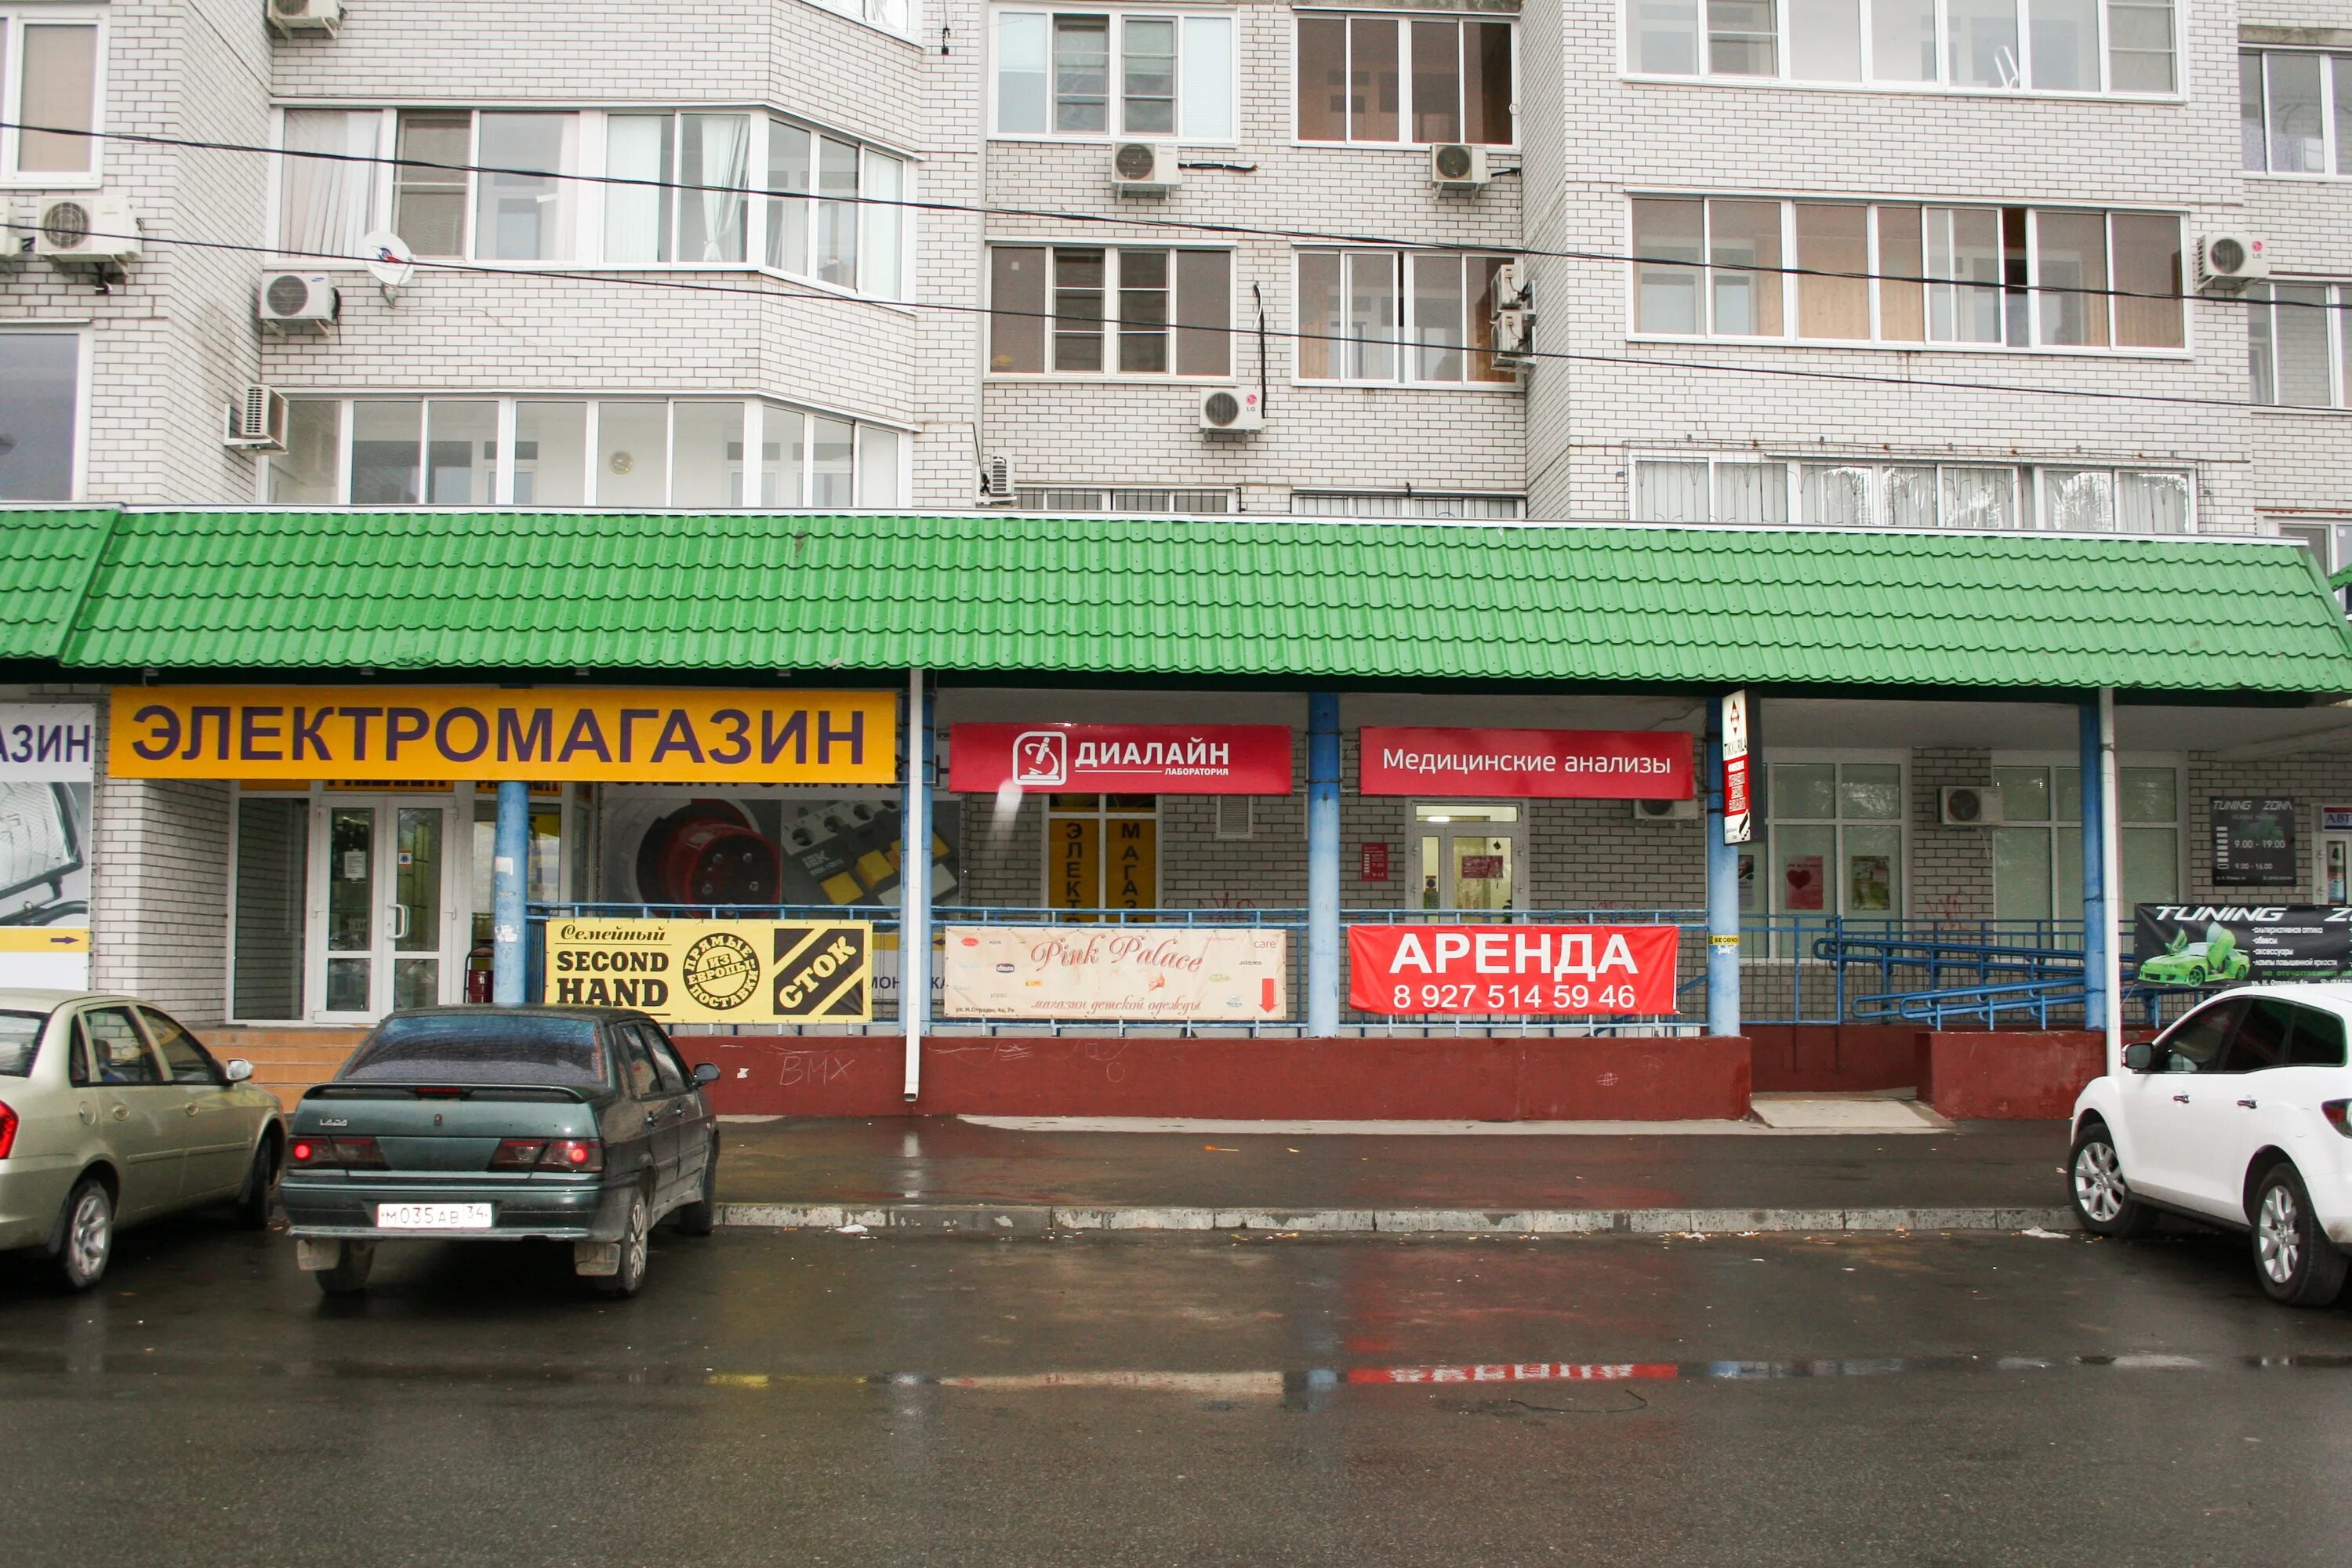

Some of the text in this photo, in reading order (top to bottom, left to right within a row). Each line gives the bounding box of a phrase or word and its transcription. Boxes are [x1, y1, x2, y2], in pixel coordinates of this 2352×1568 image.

[132, 704, 863, 765] ЭЛЕКТРОМАГАЗИН
[1075, 736, 1229, 768] ДИАЛАЙН
[1383, 748, 1671, 775] Медицинские анализы
[1164, 768, 1229, 776] ЛАБОРАТОРИЯ
[2327, 814, 2352, 823] АВТ
[2156, 906, 2288, 922] TUNING
[561, 924, 666, 941] Семейный
[557, 951, 669, 972] SECOND
[684, 935, 753, 971] ПРЯМЫЕ
[708, 956, 731, 969] ИЗ
[1030, 935, 1203, 972] Pink Palace
[1389, 933, 1639, 982] АРЕНДА
[779, 935, 857, 1009] СТОК
[557, 978, 669, 1007] HAND
[688, 970, 759, 1007] ПОСТАВКИ
[1393, 985, 1635, 1008] 8 927 514 59 46
[466, 1206, 484, 1219] 34
